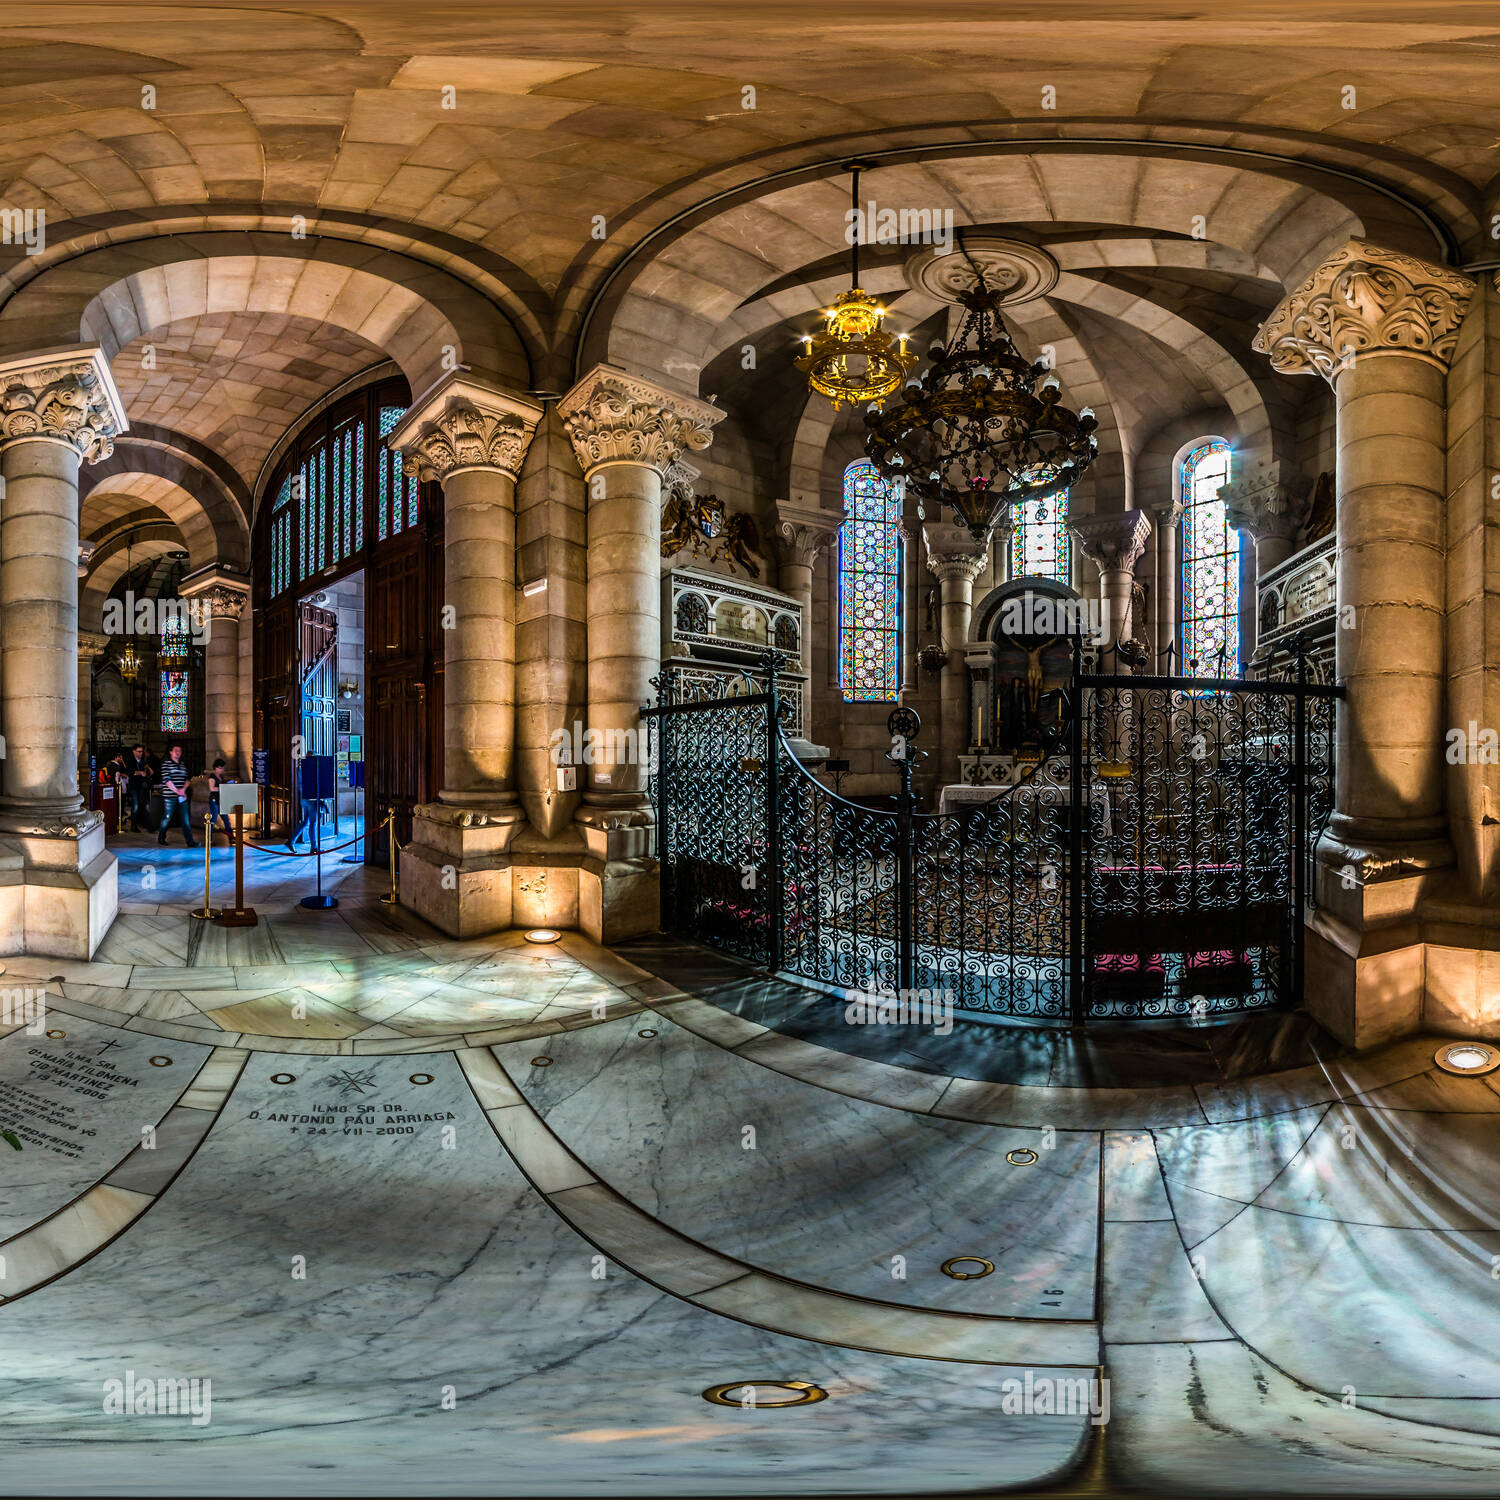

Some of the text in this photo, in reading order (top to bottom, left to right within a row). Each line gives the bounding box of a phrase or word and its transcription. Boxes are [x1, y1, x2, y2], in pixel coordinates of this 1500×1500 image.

[30, 1060, 50, 1071] CID
[78, 1065, 140, 1087] FILOMENA
[249, 1111, 456, 1125] D. ANTONIO PAU ARRIAGA
